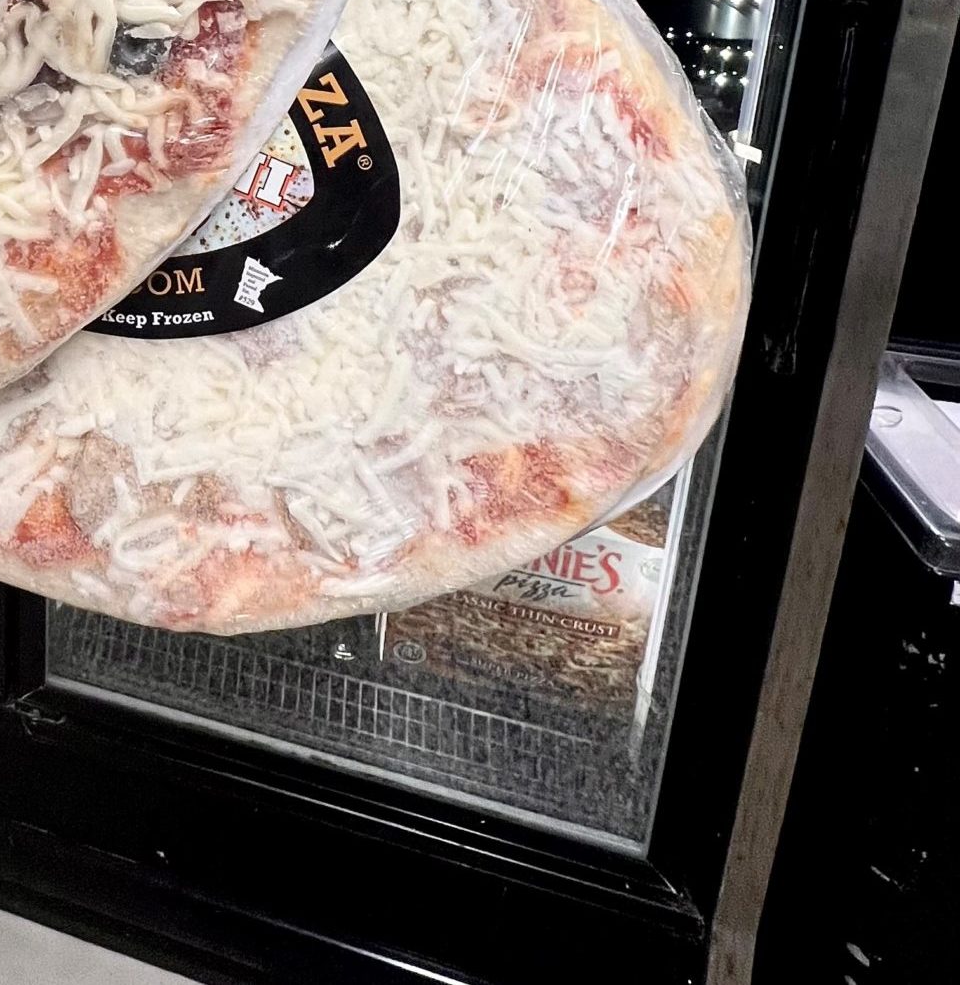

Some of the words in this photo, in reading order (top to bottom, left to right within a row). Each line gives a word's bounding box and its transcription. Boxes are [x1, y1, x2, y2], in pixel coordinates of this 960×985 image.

[101, 309, 148, 329] Keep
[151, 310, 215, 326] Frozen
[492, 573, 579, 602] pizza
[510, 605, 556, 625] THIN
[559, 616, 618, 637] CRUST
